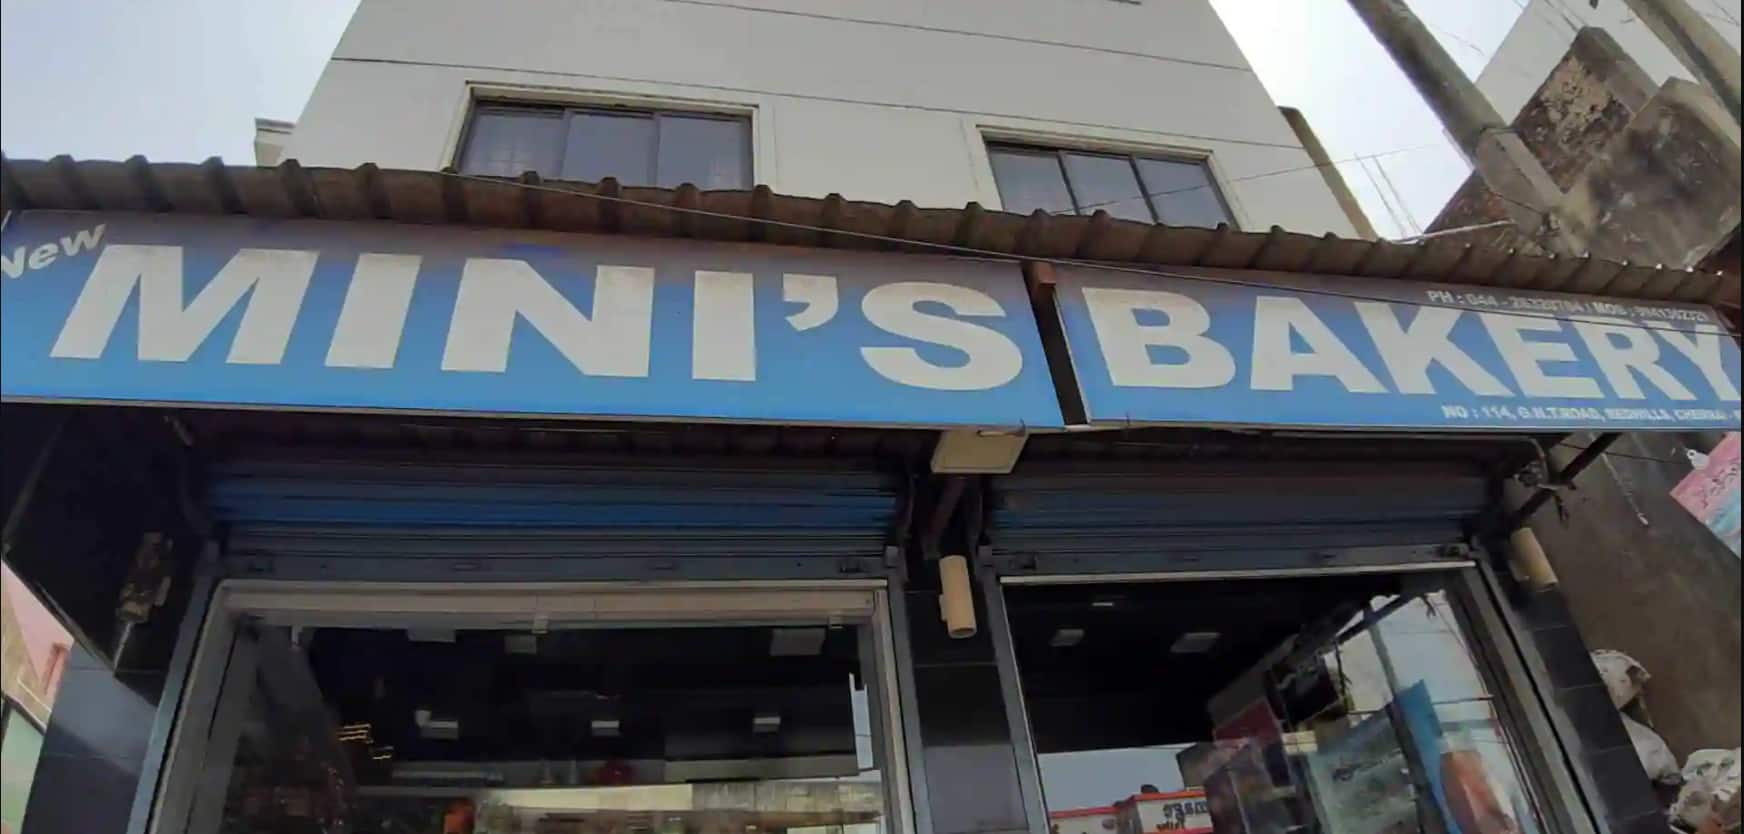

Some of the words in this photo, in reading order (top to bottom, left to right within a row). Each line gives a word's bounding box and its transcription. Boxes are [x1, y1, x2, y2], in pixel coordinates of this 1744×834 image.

[1, 224, 105, 278] New
[1427, 290, 1454, 303] PH
[50, 244, 1023, 391] MINI'S
[1082, 287, 1741, 401] BAKERY
[1441, 405, 1468, 418] NO
